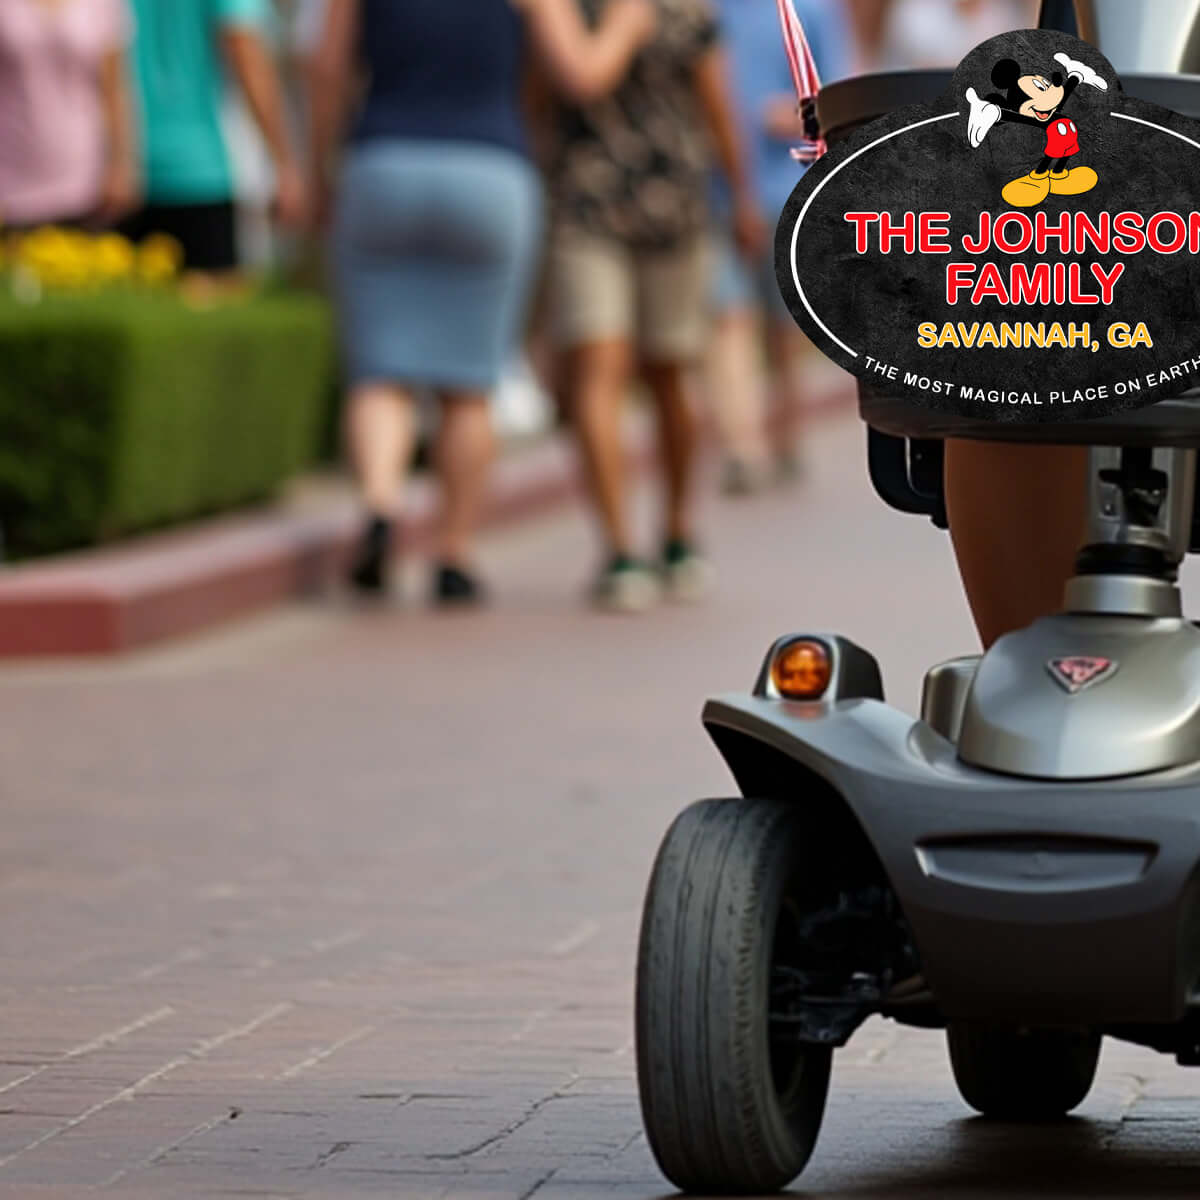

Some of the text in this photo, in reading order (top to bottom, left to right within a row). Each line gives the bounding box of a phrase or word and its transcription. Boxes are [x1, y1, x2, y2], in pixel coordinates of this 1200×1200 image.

[844, 211, 952, 254] THE
[946, 262, 1126, 306] FAMILY
[917, 321, 1154, 353] SAVANNAH, GA
[863, 354, 899, 380] THE
[903, 372, 955, 396] MOST
[959, 385, 1043, 405] MAGICAL
[1049, 385, 1109, 404] PLACE
[1114, 378, 1141, 395] ON
